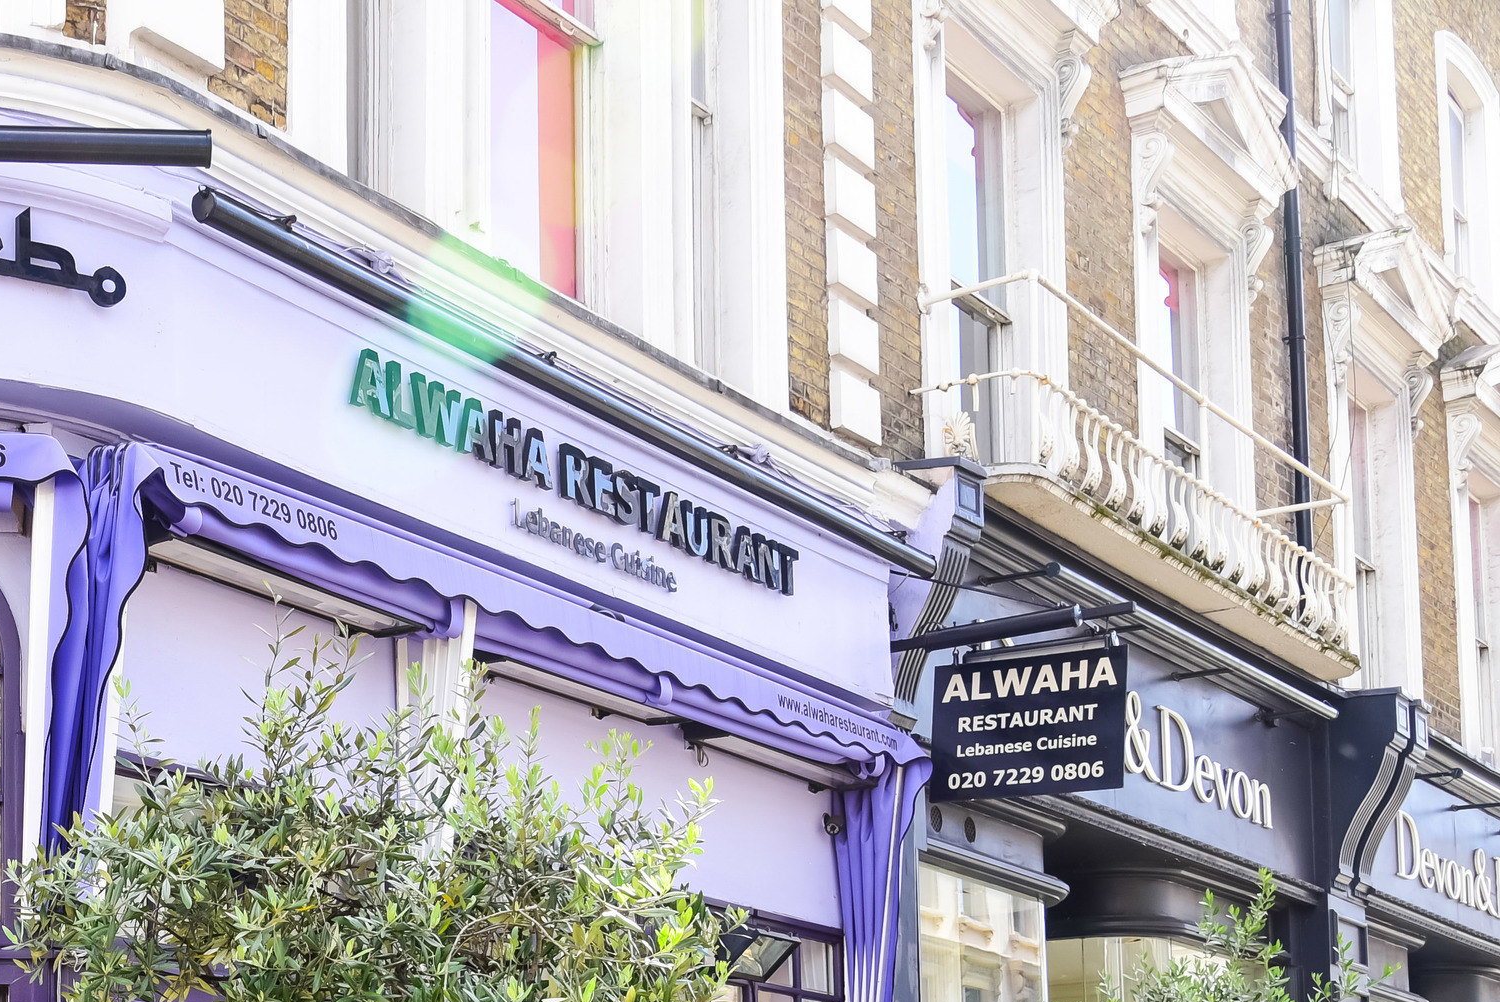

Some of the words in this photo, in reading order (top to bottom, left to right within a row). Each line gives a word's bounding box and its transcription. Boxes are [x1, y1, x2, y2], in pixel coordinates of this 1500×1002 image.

[349, 347, 553, 490] ALWAHA
[557, 442, 800, 596] RESTAURANT
[170, 462, 206, 493] Tel:
[210, 477, 244, 508] 020
[248, 490, 292, 524] 7229
[296, 508, 338, 541] 0806
[513, 499, 608, 565] Lebanese
[610, 542, 678, 593] Cuisine
[942, 656, 1117, 703] ALWAHA
[777, 693, 898, 751] www.alwaharestaurant.com
[957, 703, 1098, 733] RESTAURANT
[956, 739, 1033, 758] Lebanese
[1036, 732, 1097, 750] Cuisine
[948, 772, 987, 790] 020
[992, 767, 1046, 786] 7229
[1051, 762, 1105, 781] 0806
